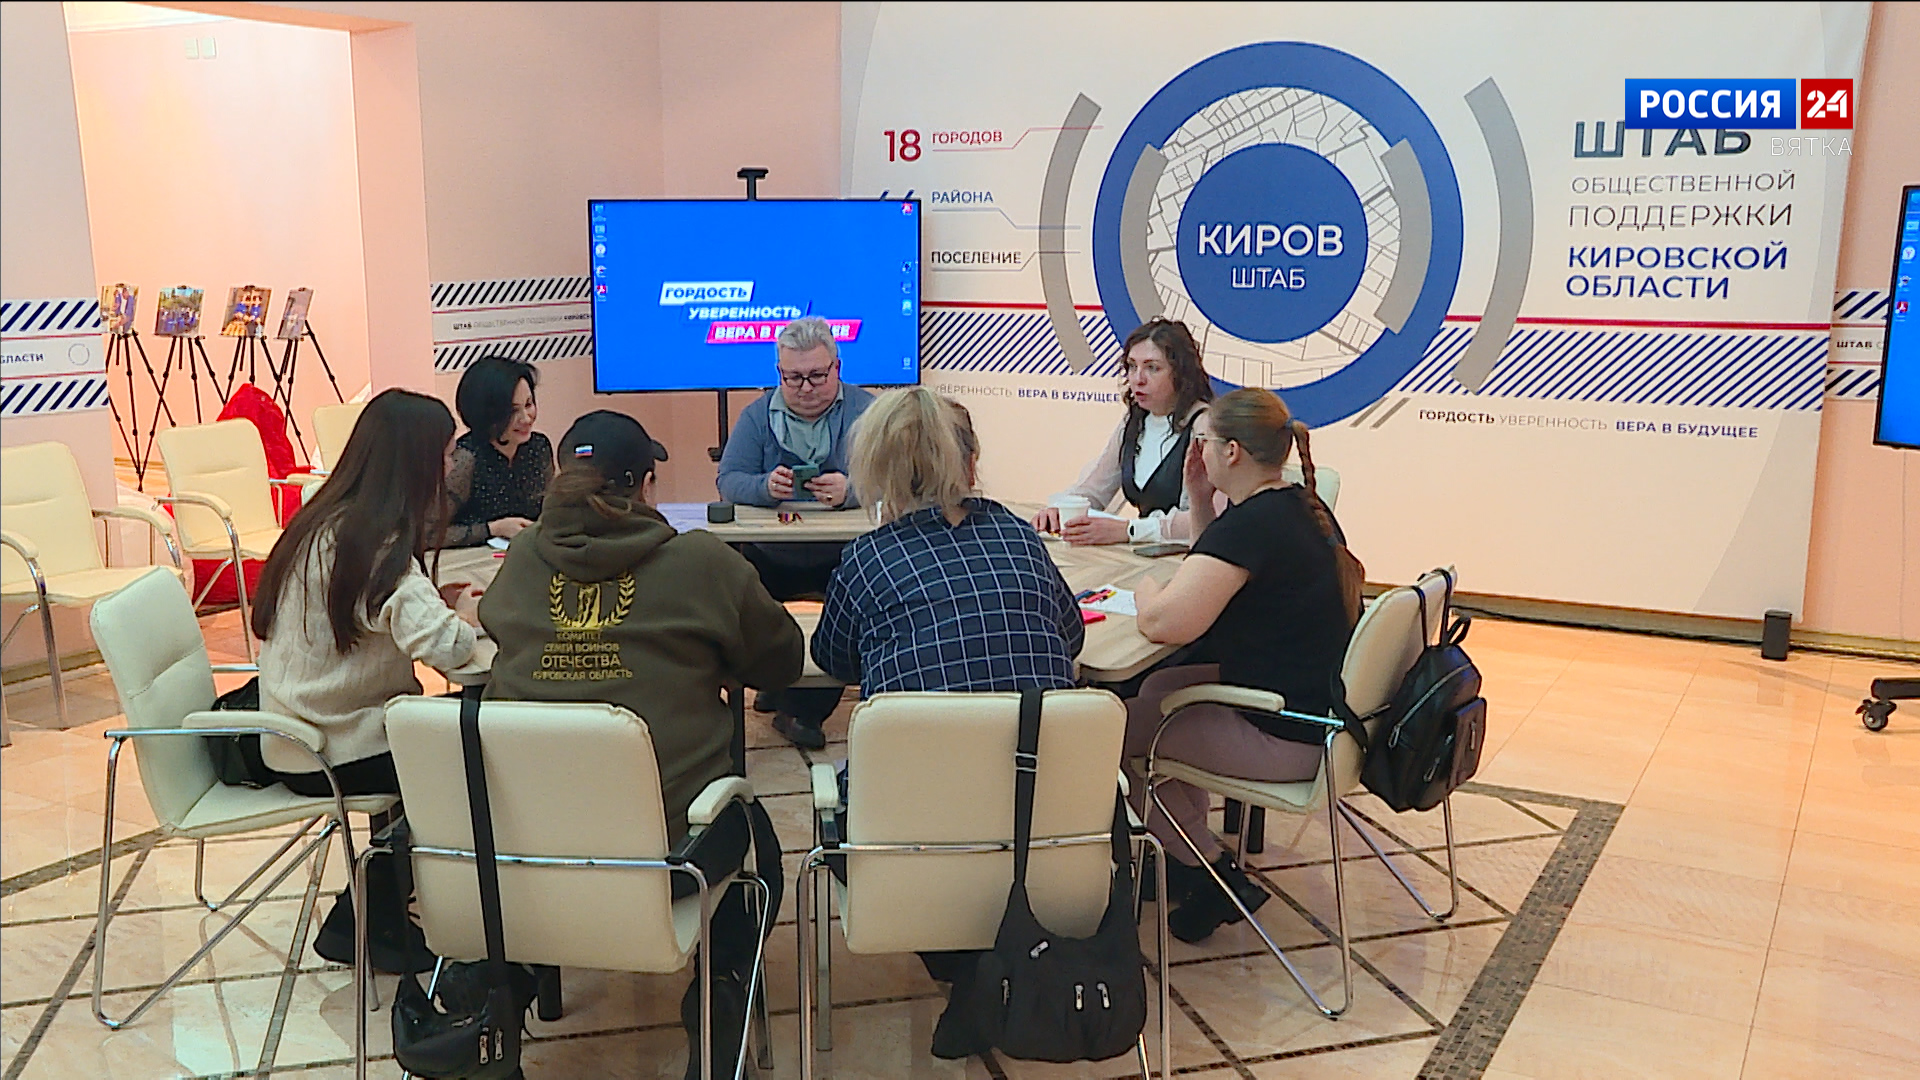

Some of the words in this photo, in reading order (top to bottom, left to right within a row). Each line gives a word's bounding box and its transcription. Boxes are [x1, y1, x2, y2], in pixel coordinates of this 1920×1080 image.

[883, 129, 922, 162] 18
[932, 131, 1003, 146] ГОРОДОВ
[1573, 120, 1752, 158] ШТАБ
[1571, 169, 1796, 196] ОБЩЕСТВЕННОЙ
[931, 190, 994, 204] РАЙОНА
[1568, 203, 1792, 232] ПОДДЕРЖКИ
[1198, 224, 1344, 256] КИРОВ
[931, 251, 1022, 264] ПОСЕЛЕНИЕ
[1567, 240, 1788, 270] КИРОВСКОЙ
[1232, 267, 1306, 289] ШТАБ
[665, 287, 748, 300] ГОРДОСТЬ
[1565, 275, 1729, 299] ОБЛАСТИ
[688, 306, 802, 320] УВЕРЕННОСТЬ
[714, 325, 756, 339] ВЕРА
[759, 325, 771, 339] В
[1836, 341, 1873, 349] ШТАБ
[1018, 388, 1048, 398] ВЕРА
[1051, 390, 1060, 399] В
[1062, 391, 1120, 403] БУДУЩЕЕ
[1419, 409, 1495, 424] ГОРДОСТЬ
[1499, 413, 1607, 430] УВЕРЕННОСТЬ
[1616, 420, 1656, 432] ВЕРА
[1662, 422, 1672, 434] В
[1677, 423, 1759, 438] БУДУЩЕЕ
[575, 642, 620, 653] ВОИНОВ
[541, 654, 621, 668] ОТЕЧЕСТВА
[588, 669, 633, 681] ОБЛАСТЬ
